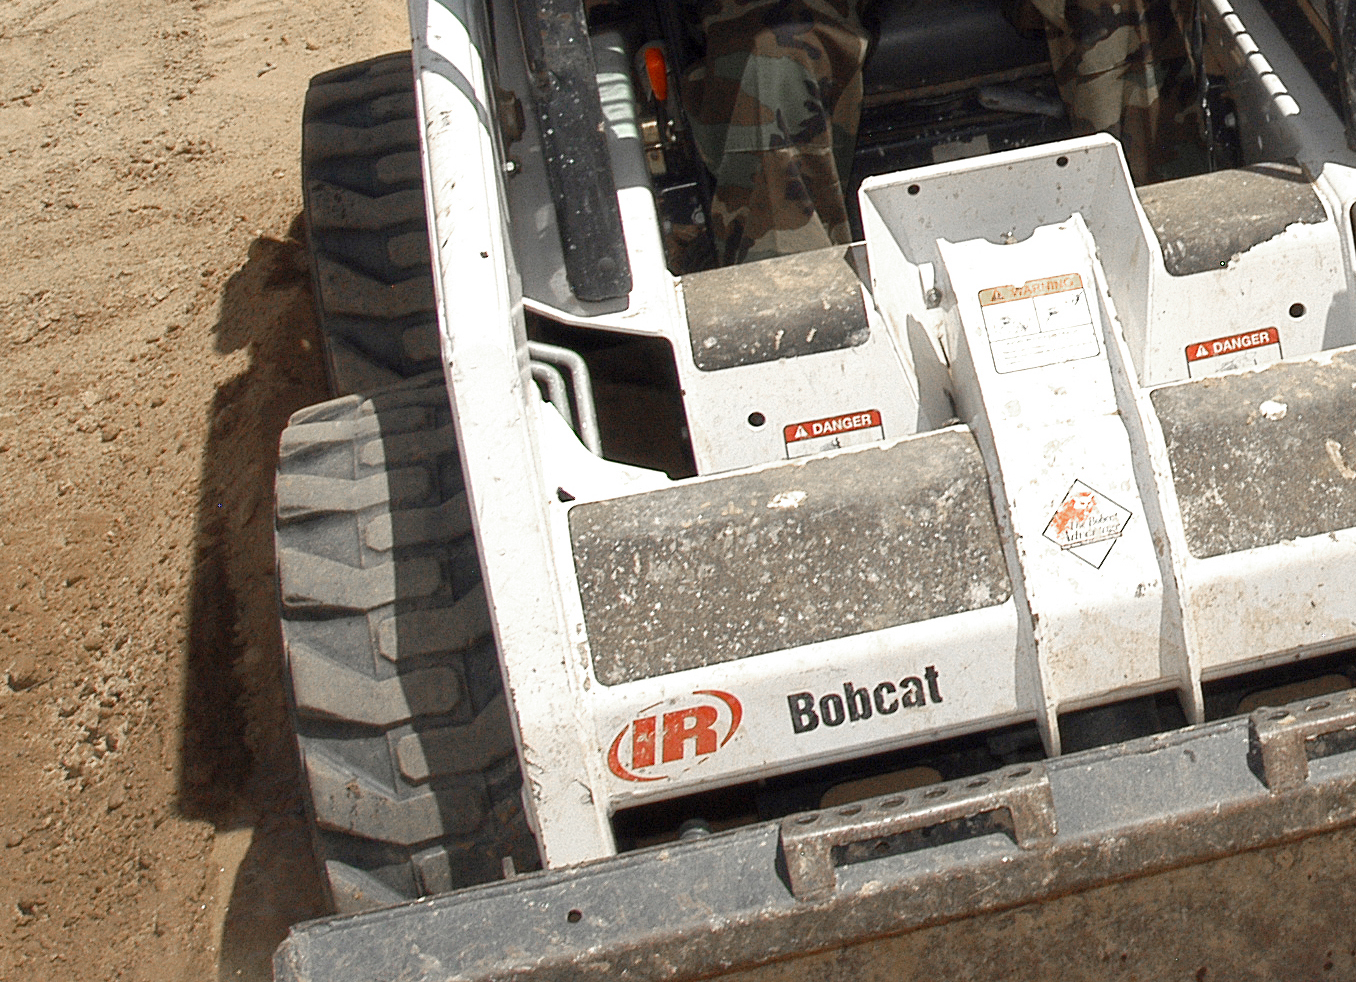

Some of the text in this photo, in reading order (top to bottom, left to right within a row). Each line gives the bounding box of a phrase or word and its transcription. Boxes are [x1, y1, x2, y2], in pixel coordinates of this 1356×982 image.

[1212, 331, 1270, 354] DANGER
[812, 414, 872, 434] DANGER
[787, 665, 944, 734] Bobcat
[631, 705, 718, 769] IR
